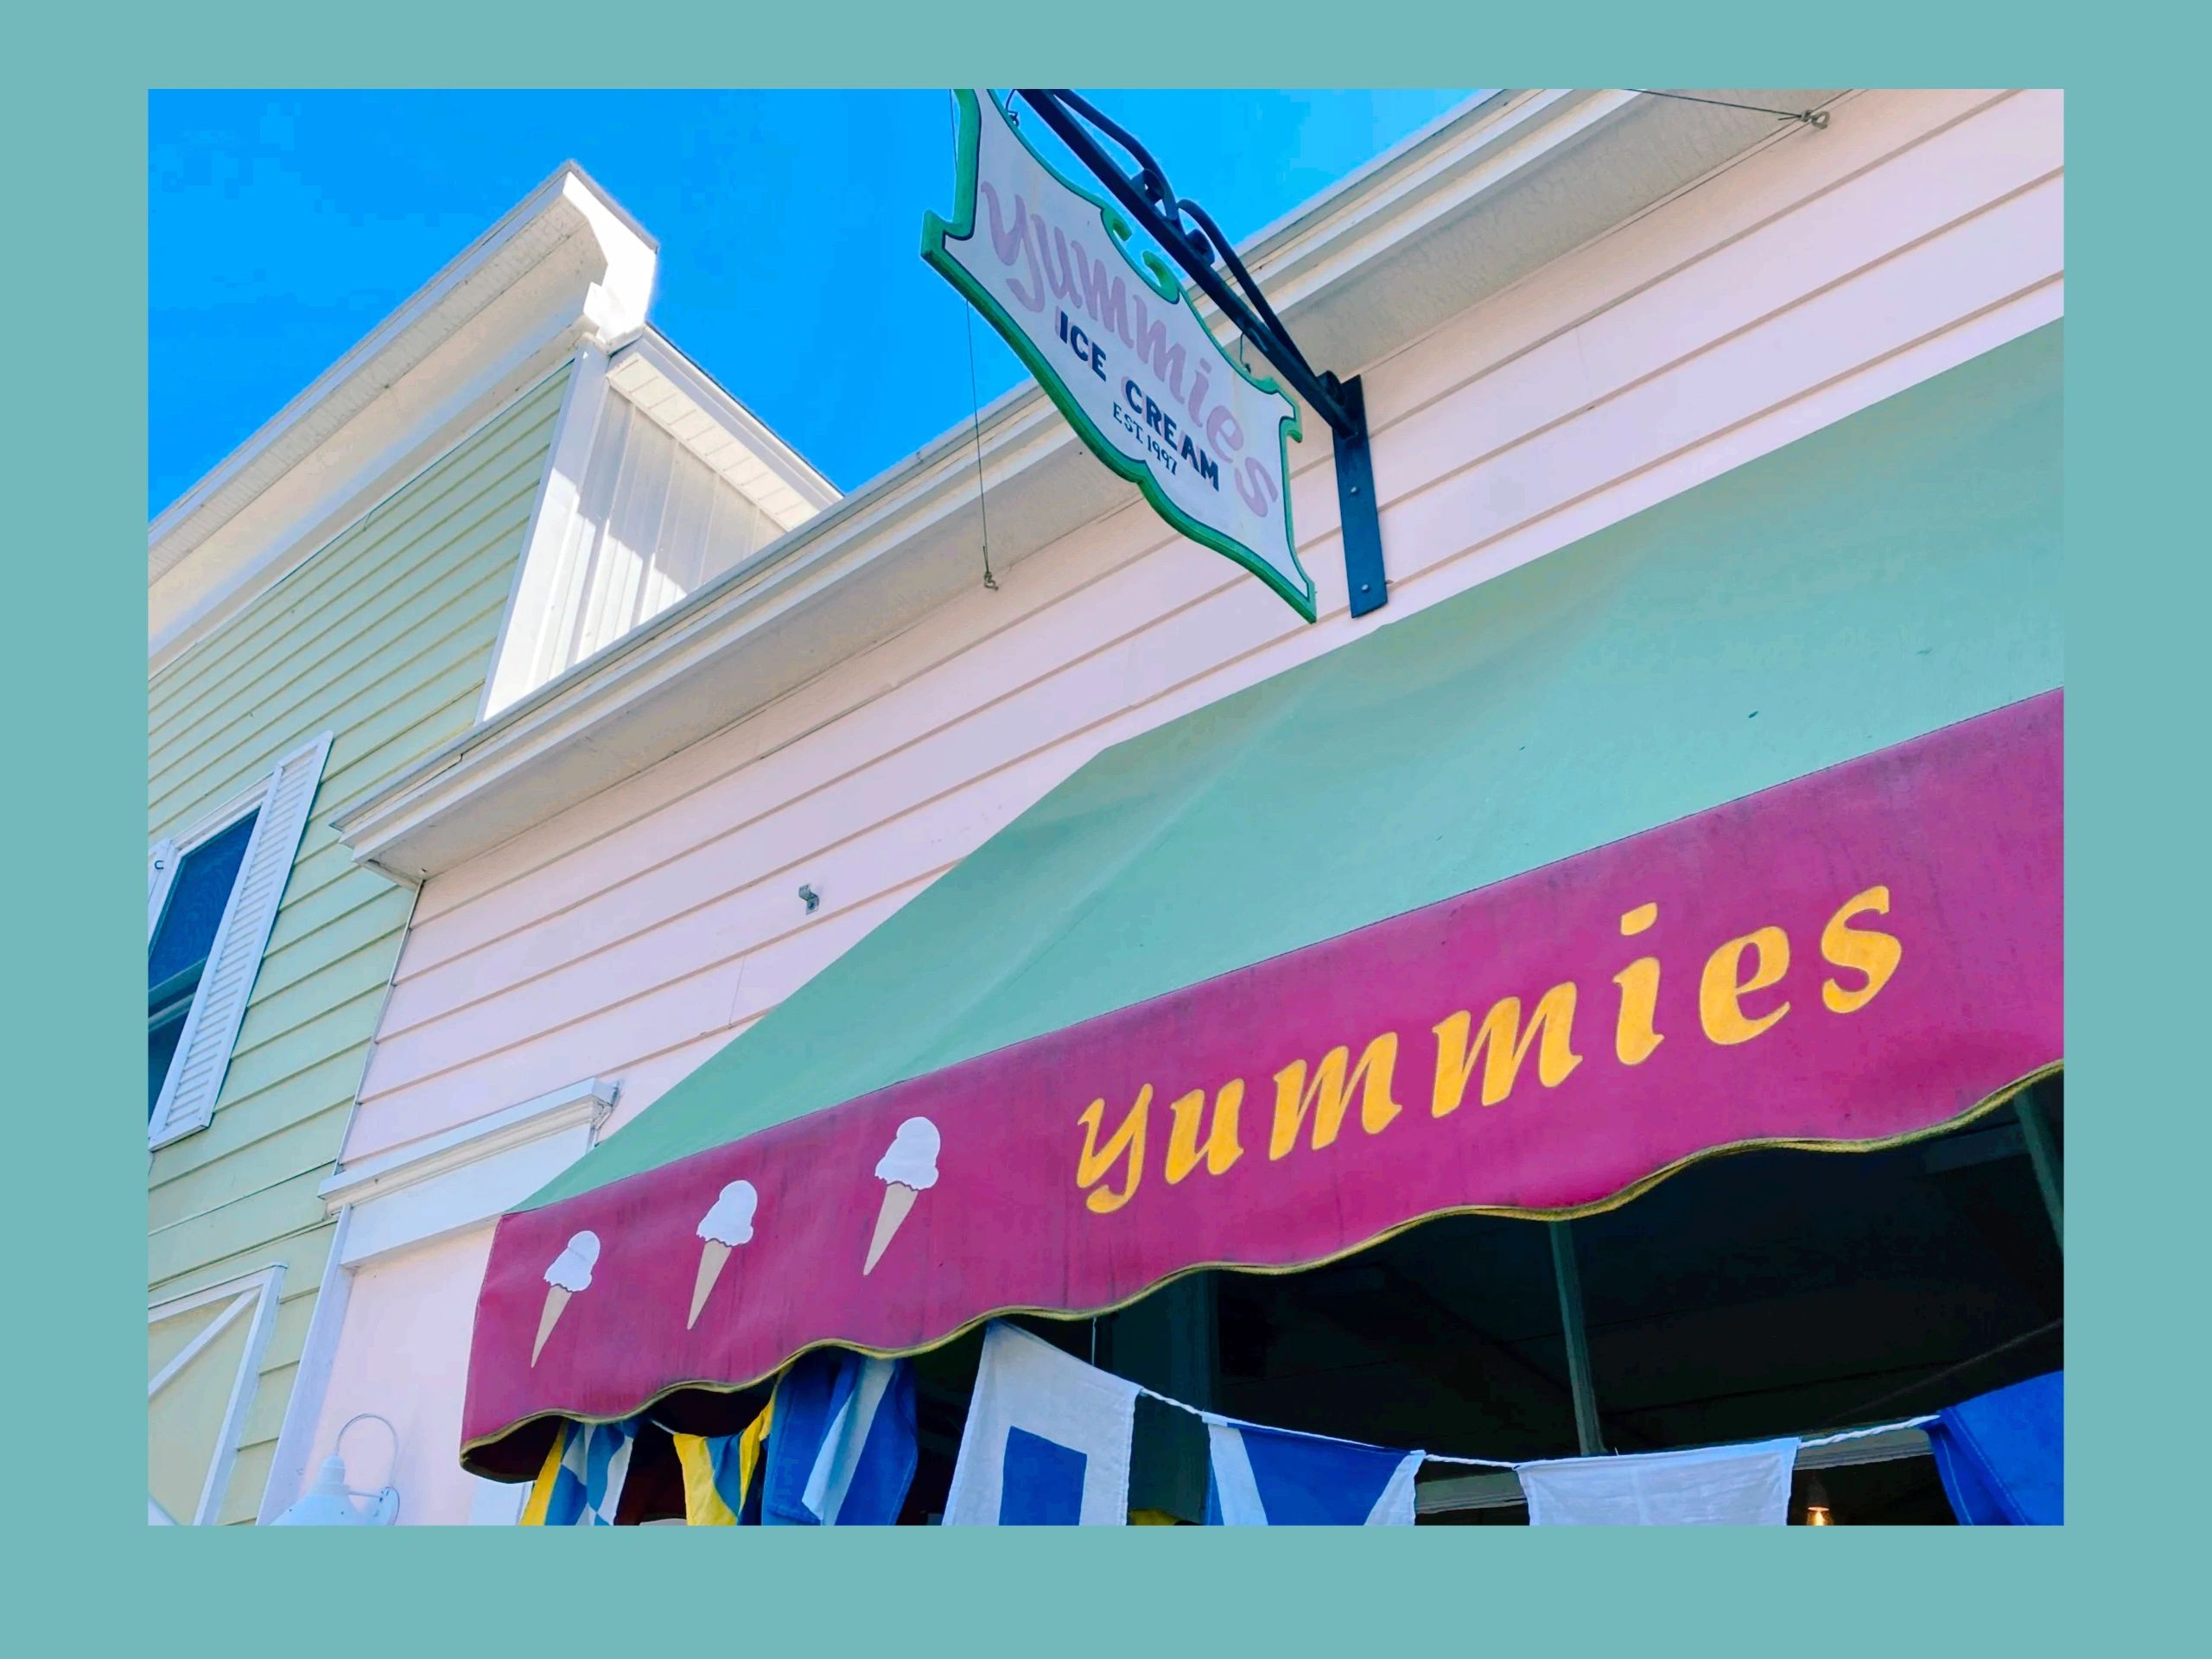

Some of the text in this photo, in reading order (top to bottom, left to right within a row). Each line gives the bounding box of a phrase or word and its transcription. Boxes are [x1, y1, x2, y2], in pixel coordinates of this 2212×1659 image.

[1058, 310, 1220, 493] ICE CREAM
[1147, 435, 1178, 476] 1997
